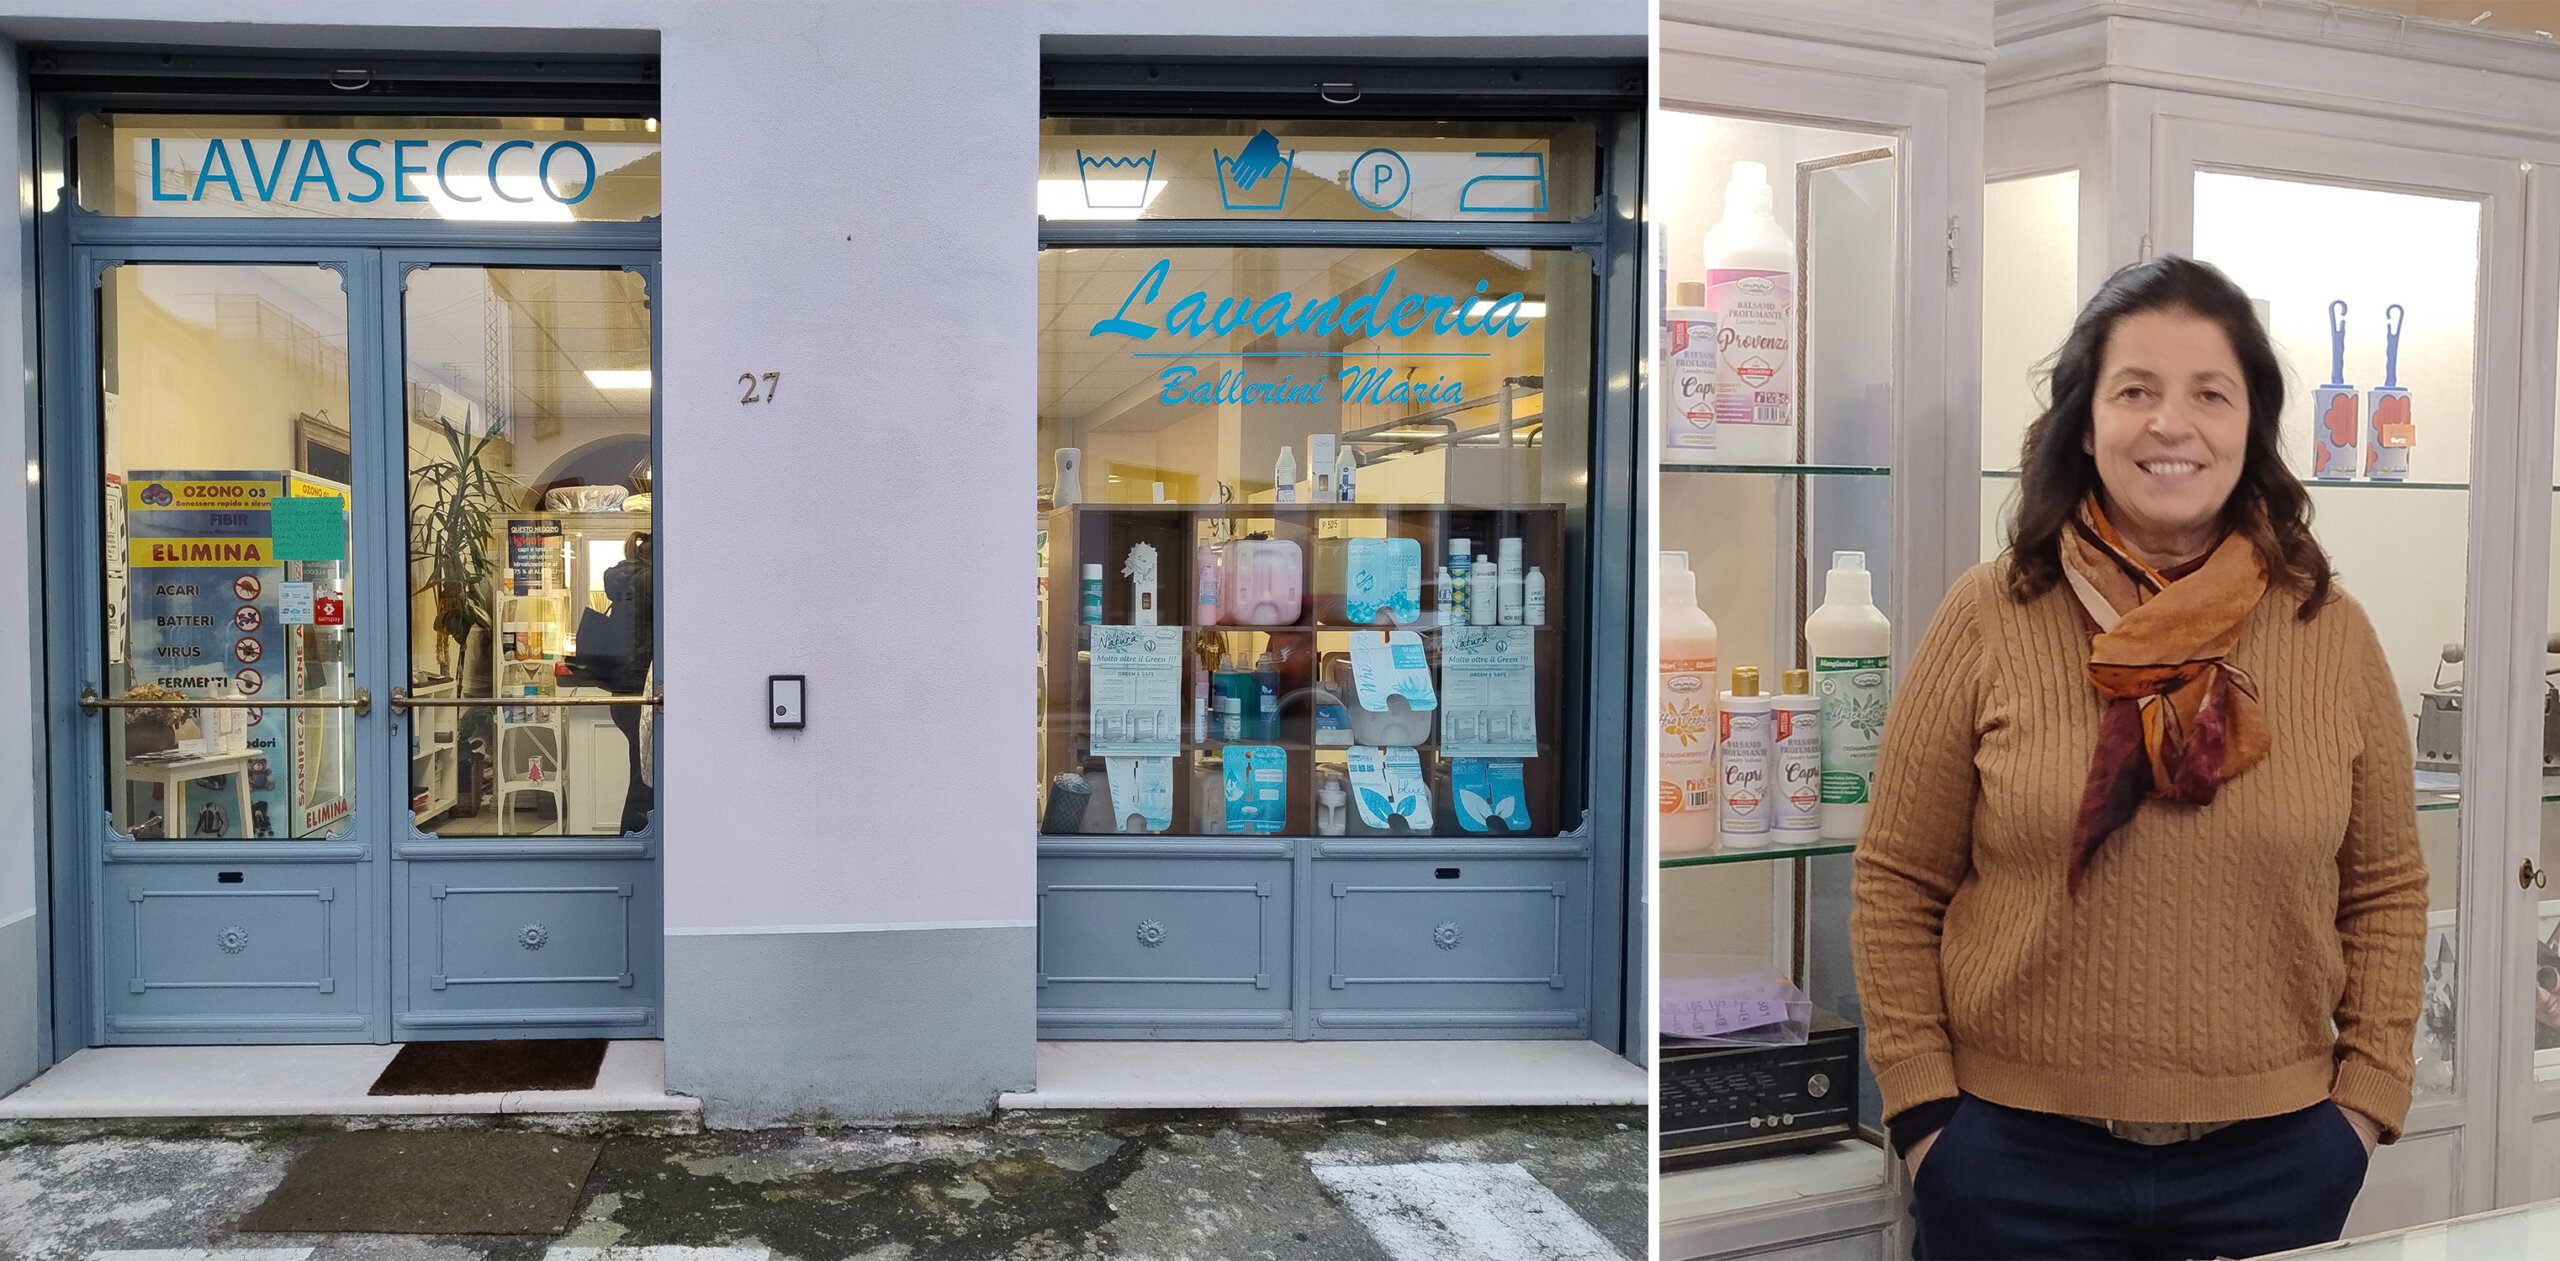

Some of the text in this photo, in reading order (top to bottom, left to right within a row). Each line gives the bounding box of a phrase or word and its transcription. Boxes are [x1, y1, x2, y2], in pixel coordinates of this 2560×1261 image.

[150, 137, 596, 206] LAVASECCO
[1089, 258, 1531, 340] Lavanderia
[738, 371, 781, 405] 27
[1161, 365, 1464, 407] Ballerini Maria
[183, 485, 244, 498] OZONO
[175, 500, 216, 508] Benessere
[217, 499, 242, 509] rapido
[251, 499, 272, 508] sicur
[209, 513, 249, 526] FIBIR
[152, 543, 261, 562] ELIMINA
[156, 584, 199, 596] ACARI
[156, 615, 215, 627] BATTERI
[1098, 633, 1139, 649] Natura
[1450, 635, 1489, 650] Natura
[157, 646, 201, 658] VIRUS
[1096, 655, 1118, 663] Molto
[1138, 655, 1145, 663] il
[1145, 655, 1166, 663] Green
[1471, 655, 1489, 663] oltre
[296, 645, 305, 807] SANIFICAIONE
[1725, 765, 1763, 788] Capri
[306, 798, 348, 829] ELIMINA
